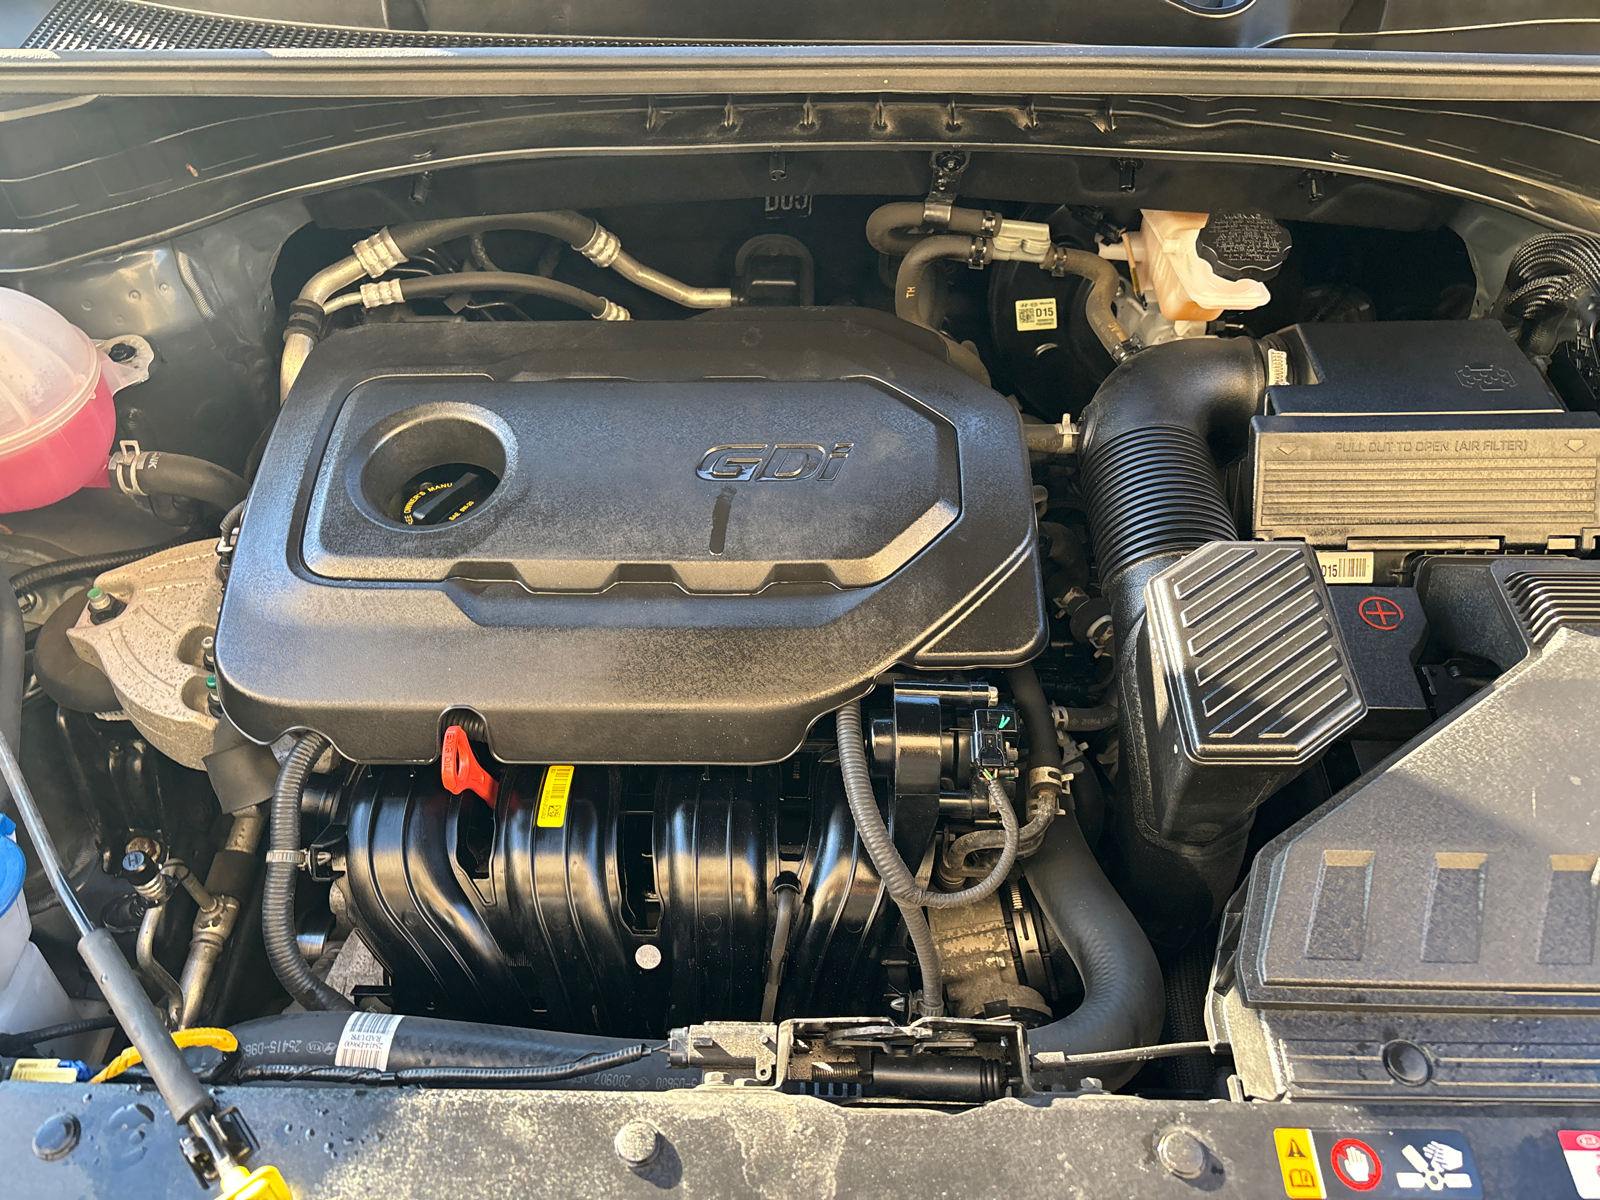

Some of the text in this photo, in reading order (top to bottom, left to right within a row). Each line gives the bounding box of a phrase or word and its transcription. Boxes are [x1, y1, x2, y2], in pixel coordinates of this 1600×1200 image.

[1035, 307, 1054, 318] D15
[1335, 442, 1365, 453] PULL
[1368, 442, 1393, 452] OUT
[1393, 441, 1412, 452] TO
[1415, 441, 1449, 452] OPEN
[695, 442, 856, 482] GDi
[443, 733, 455, 772] ENG OIL
[244, 1038, 303, 1057] 25415-D96
